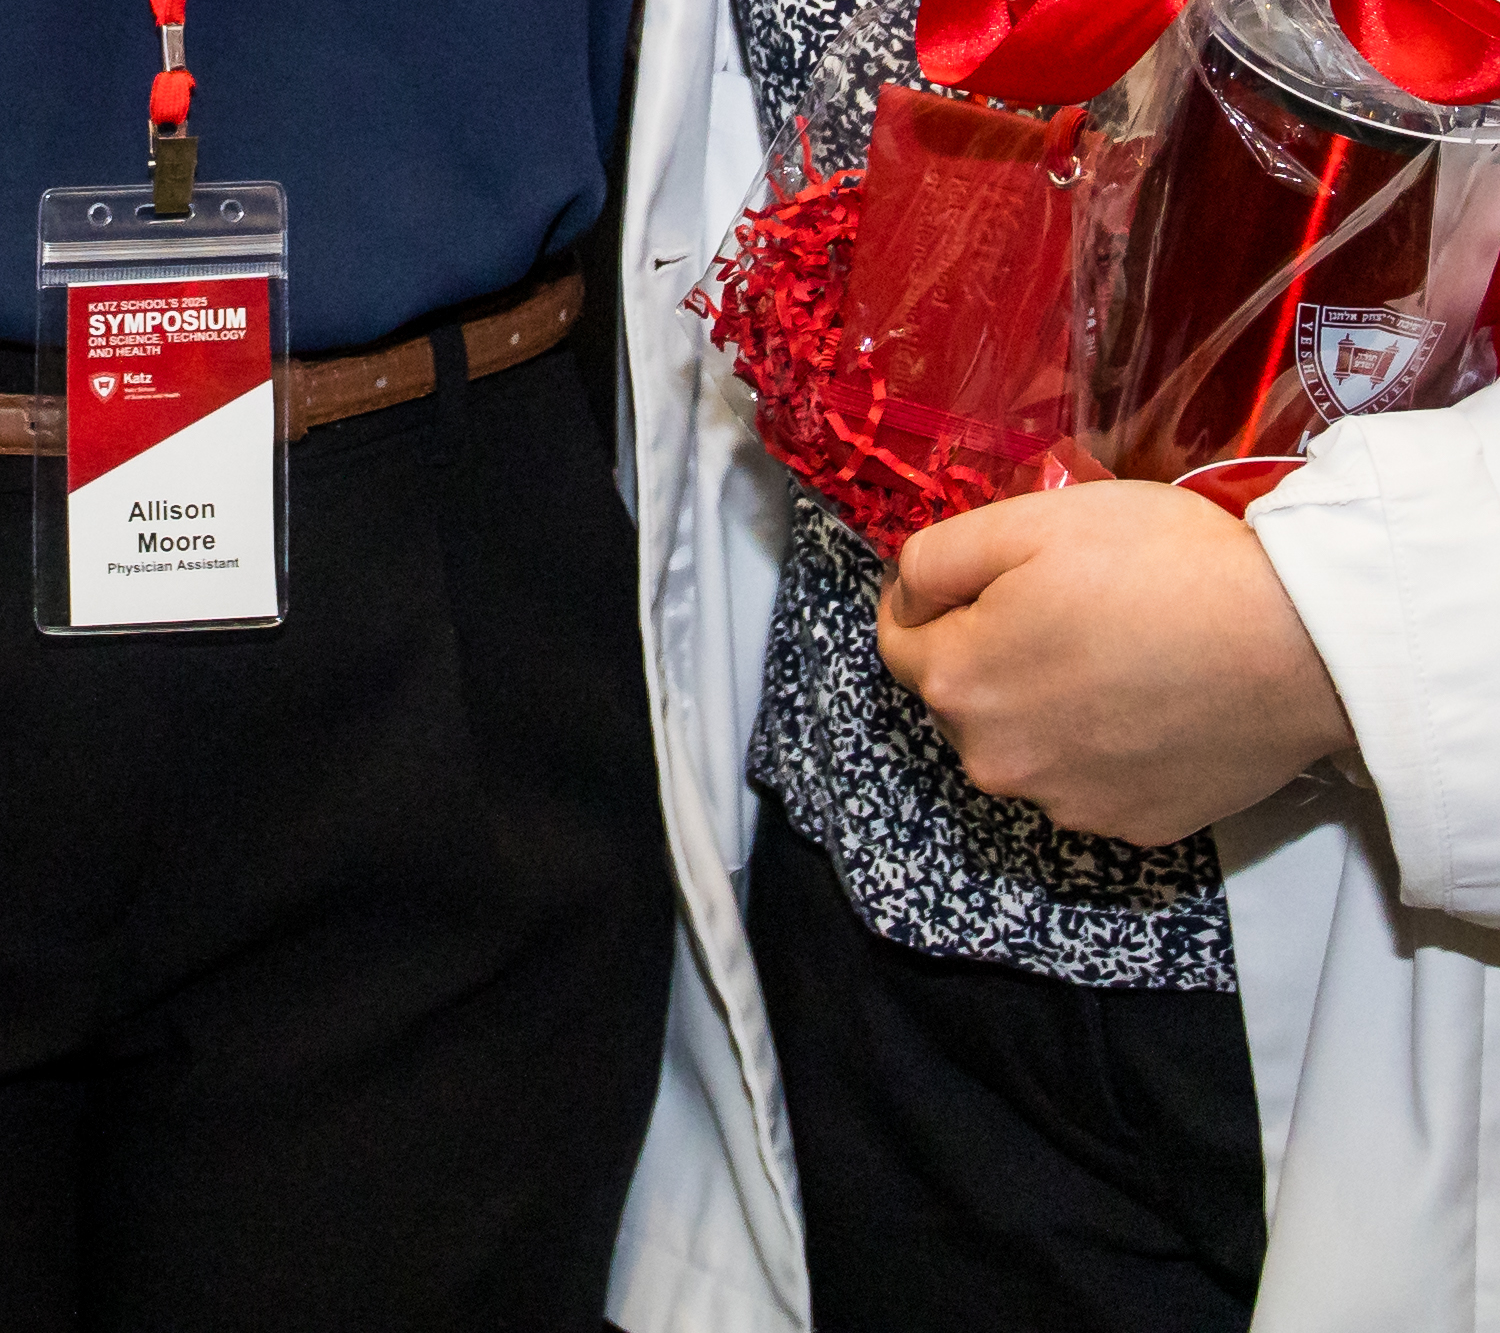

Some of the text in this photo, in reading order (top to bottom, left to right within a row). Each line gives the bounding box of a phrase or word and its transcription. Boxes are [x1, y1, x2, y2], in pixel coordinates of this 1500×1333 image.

[88, 302, 118, 312] KATZ
[120, 298, 179, 310] SCHOOL'S
[89, 307, 247, 336] SYMPOSIUM
[88, 336, 106, 347] ON
[166, 330, 247, 343] TECHNOLOGY
[88, 346, 161, 358] AND HEALTH
[1300, 321, 1332, 412] YESHIVA
[124, 373, 152, 384] Katz
[128, 499, 215, 522] Allison
[138, 532, 216, 553] Moore
[107, 558, 240, 576] Physician Assistant
